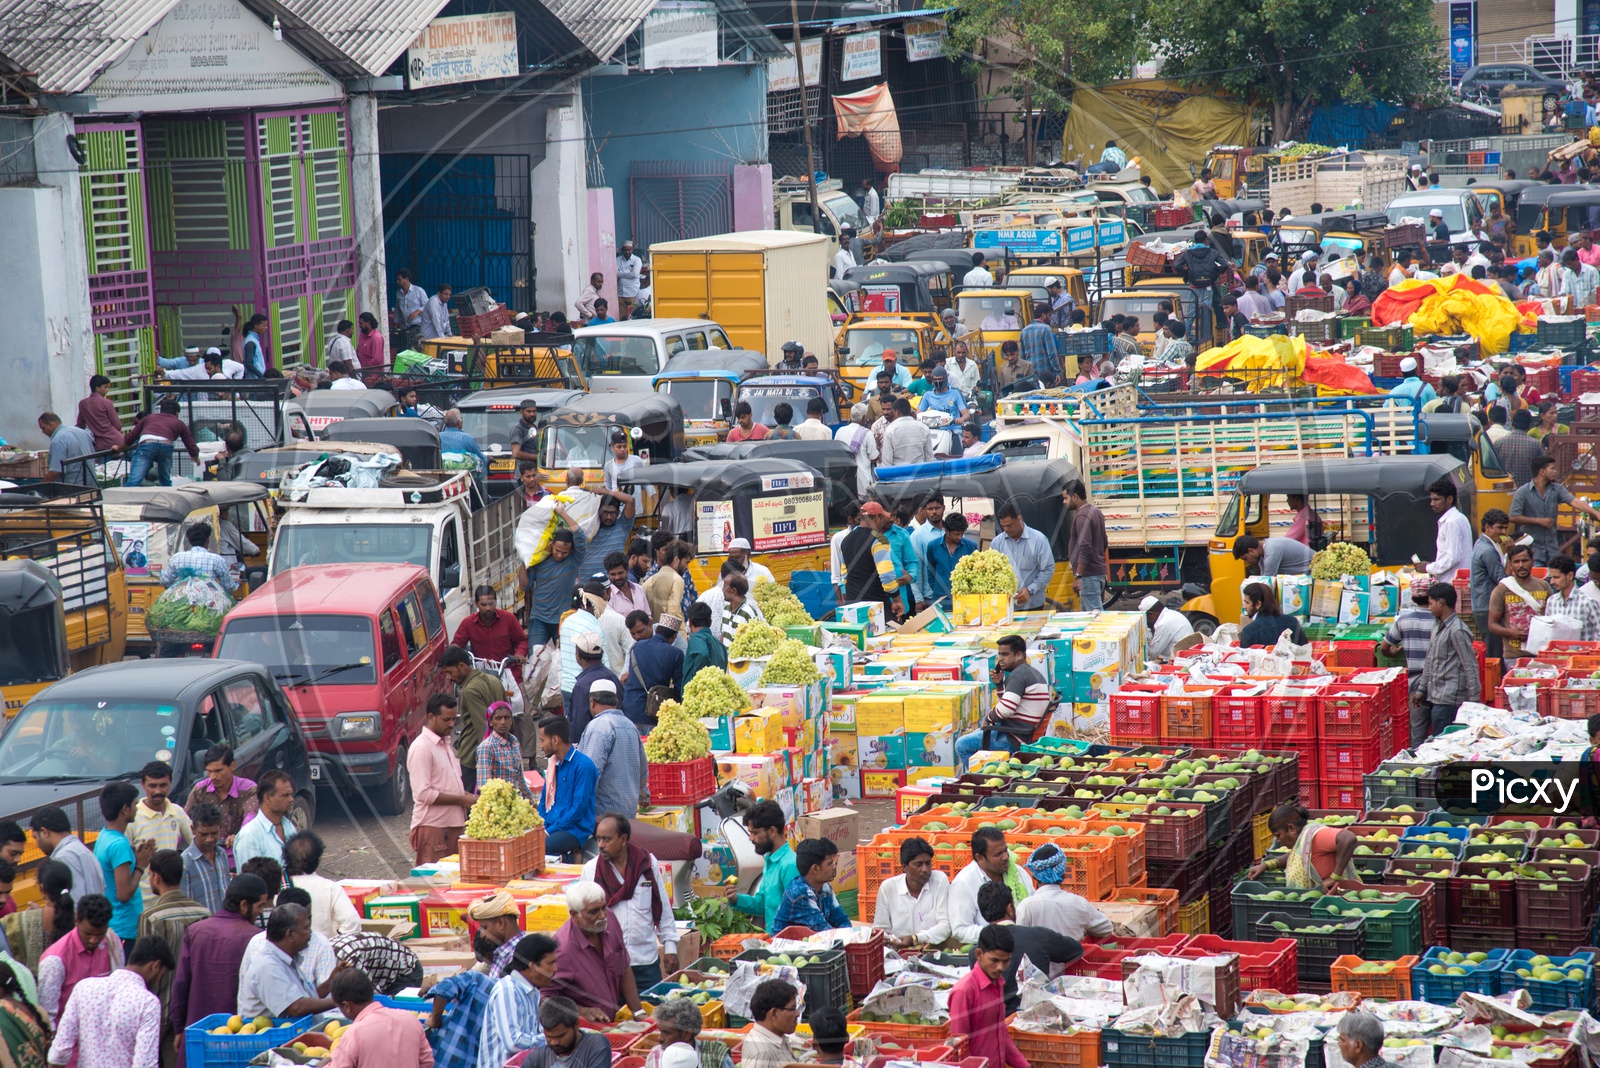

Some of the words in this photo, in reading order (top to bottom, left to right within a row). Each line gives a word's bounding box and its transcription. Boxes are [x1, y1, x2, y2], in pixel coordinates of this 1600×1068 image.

[429, 22, 474, 49] BOMBAY
[476, 19, 500, 43] FRUIT
[754, 389, 764, 397] JAI
[766, 388, 783, 396] MATA
[772, 479, 788, 487] IIFL
[784, 494, 822, 505] 08030088400
[775, 522, 795, 532] IIFL
[866, 779, 885, 787] Healthy
